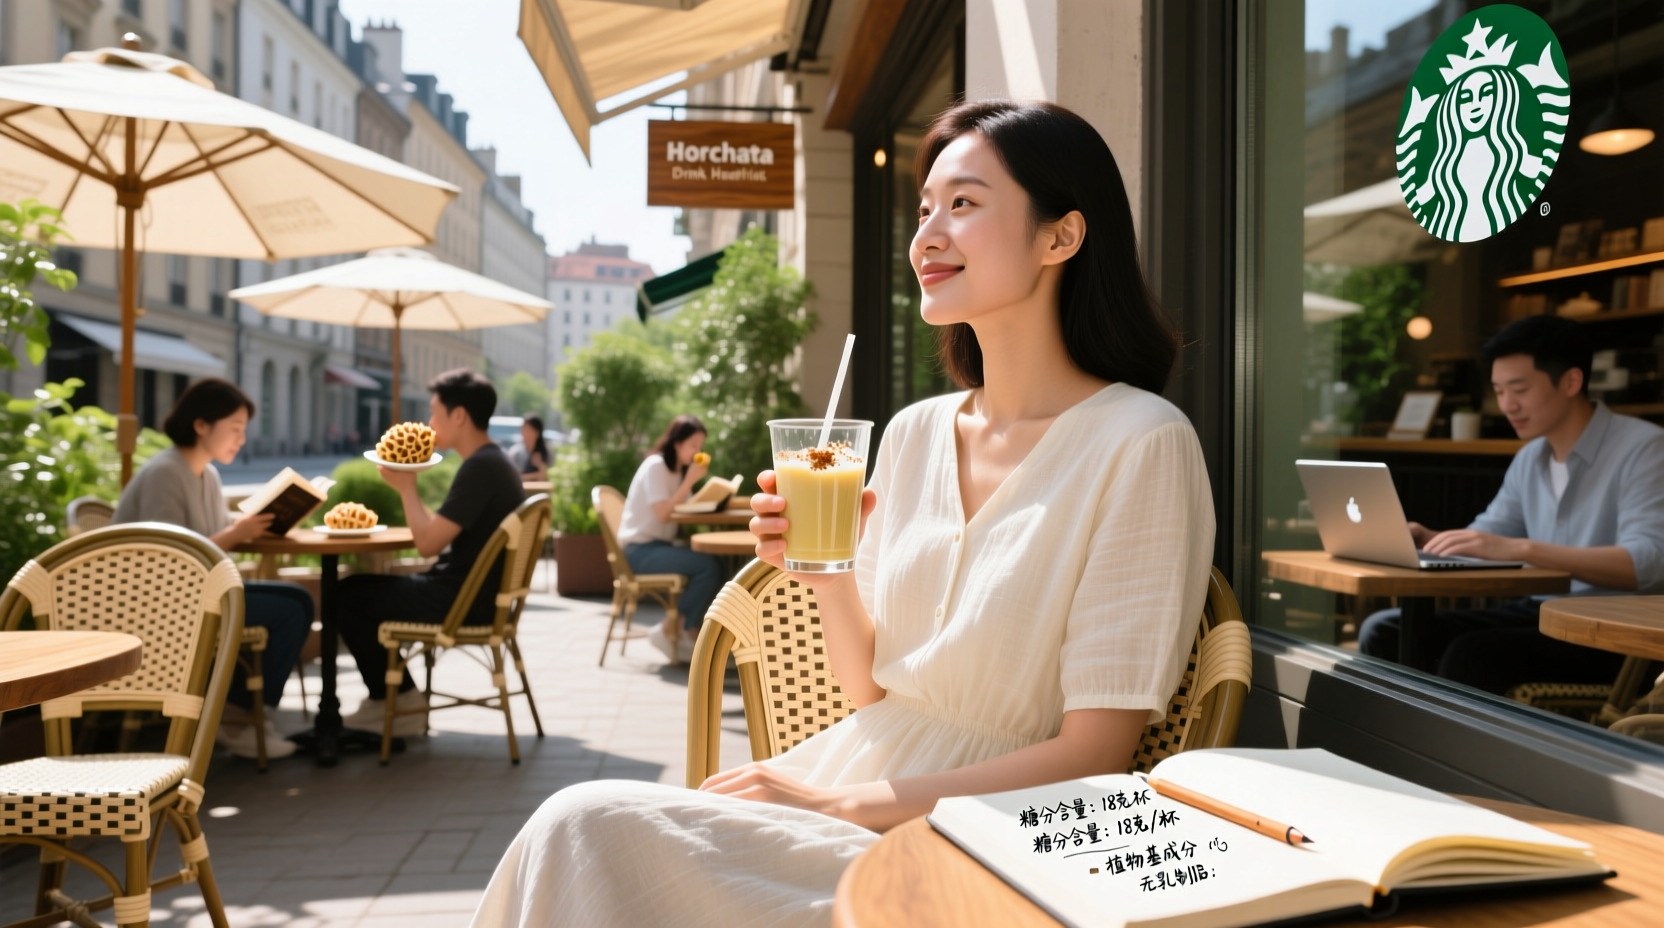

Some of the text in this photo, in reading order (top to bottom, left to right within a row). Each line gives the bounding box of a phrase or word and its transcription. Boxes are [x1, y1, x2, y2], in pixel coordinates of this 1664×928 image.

[666, 141, 774, 165] Horchata
[1105, 840, 1197, 875] 植物基成分
